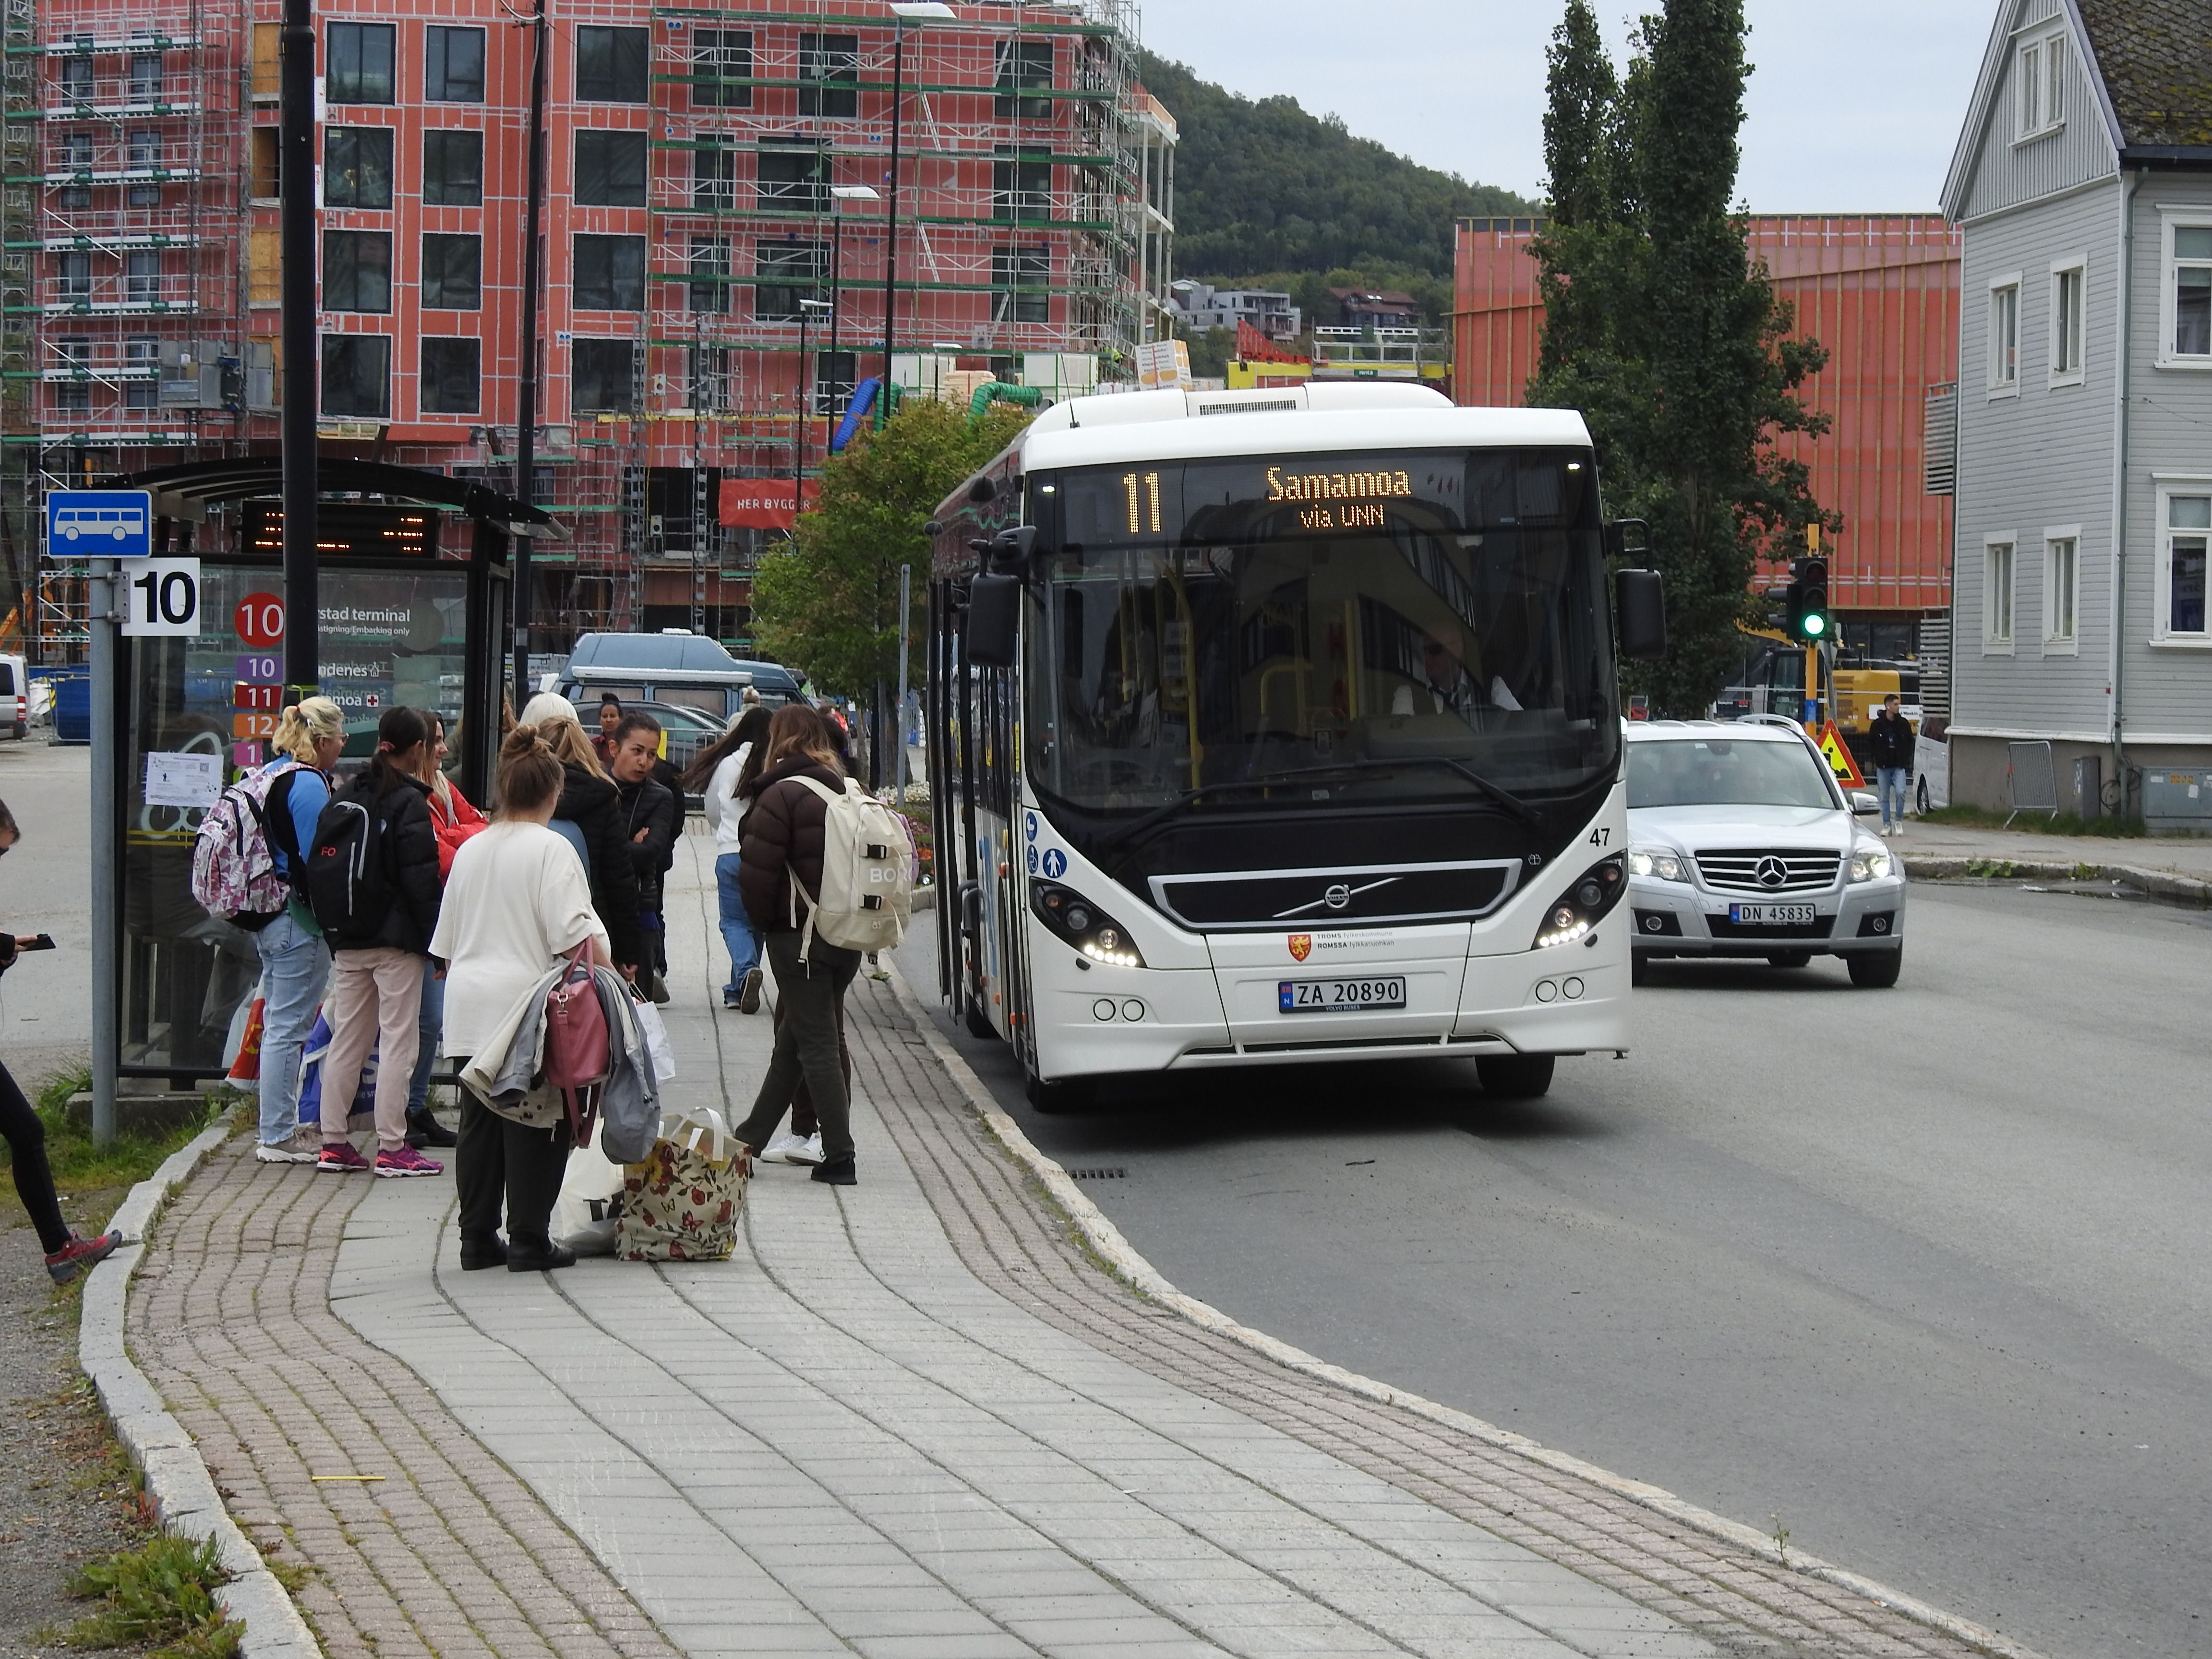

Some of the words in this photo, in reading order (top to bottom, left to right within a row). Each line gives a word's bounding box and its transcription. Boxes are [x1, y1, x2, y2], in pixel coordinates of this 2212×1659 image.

[1266, 466, 1412, 502] Samamoa
[737, 498, 760, 510] HER
[764, 498, 811, 510] BYGGR
[1123, 472, 1161, 533] 11
[1300, 504, 1334, 528] via
[1341, 504, 1384, 528] UNN
[134, 571, 196, 624] 10
[241, 603, 284, 637] 10
[352, 608, 410, 622] terminal
[394, 627, 410, 637] only
[249, 658, 276, 678] 10
[248, 687, 271, 707] 11
[247, 715, 273, 735] 12
[247, 744, 263, 764] 1
[1589, 828, 1611, 847] 47
[1742, 907, 1761, 920] DN
[1769, 907, 1812, 920] 45835
[1298, 985, 1323, 1004] ZA
[1334, 982, 1399, 1003] 20890
